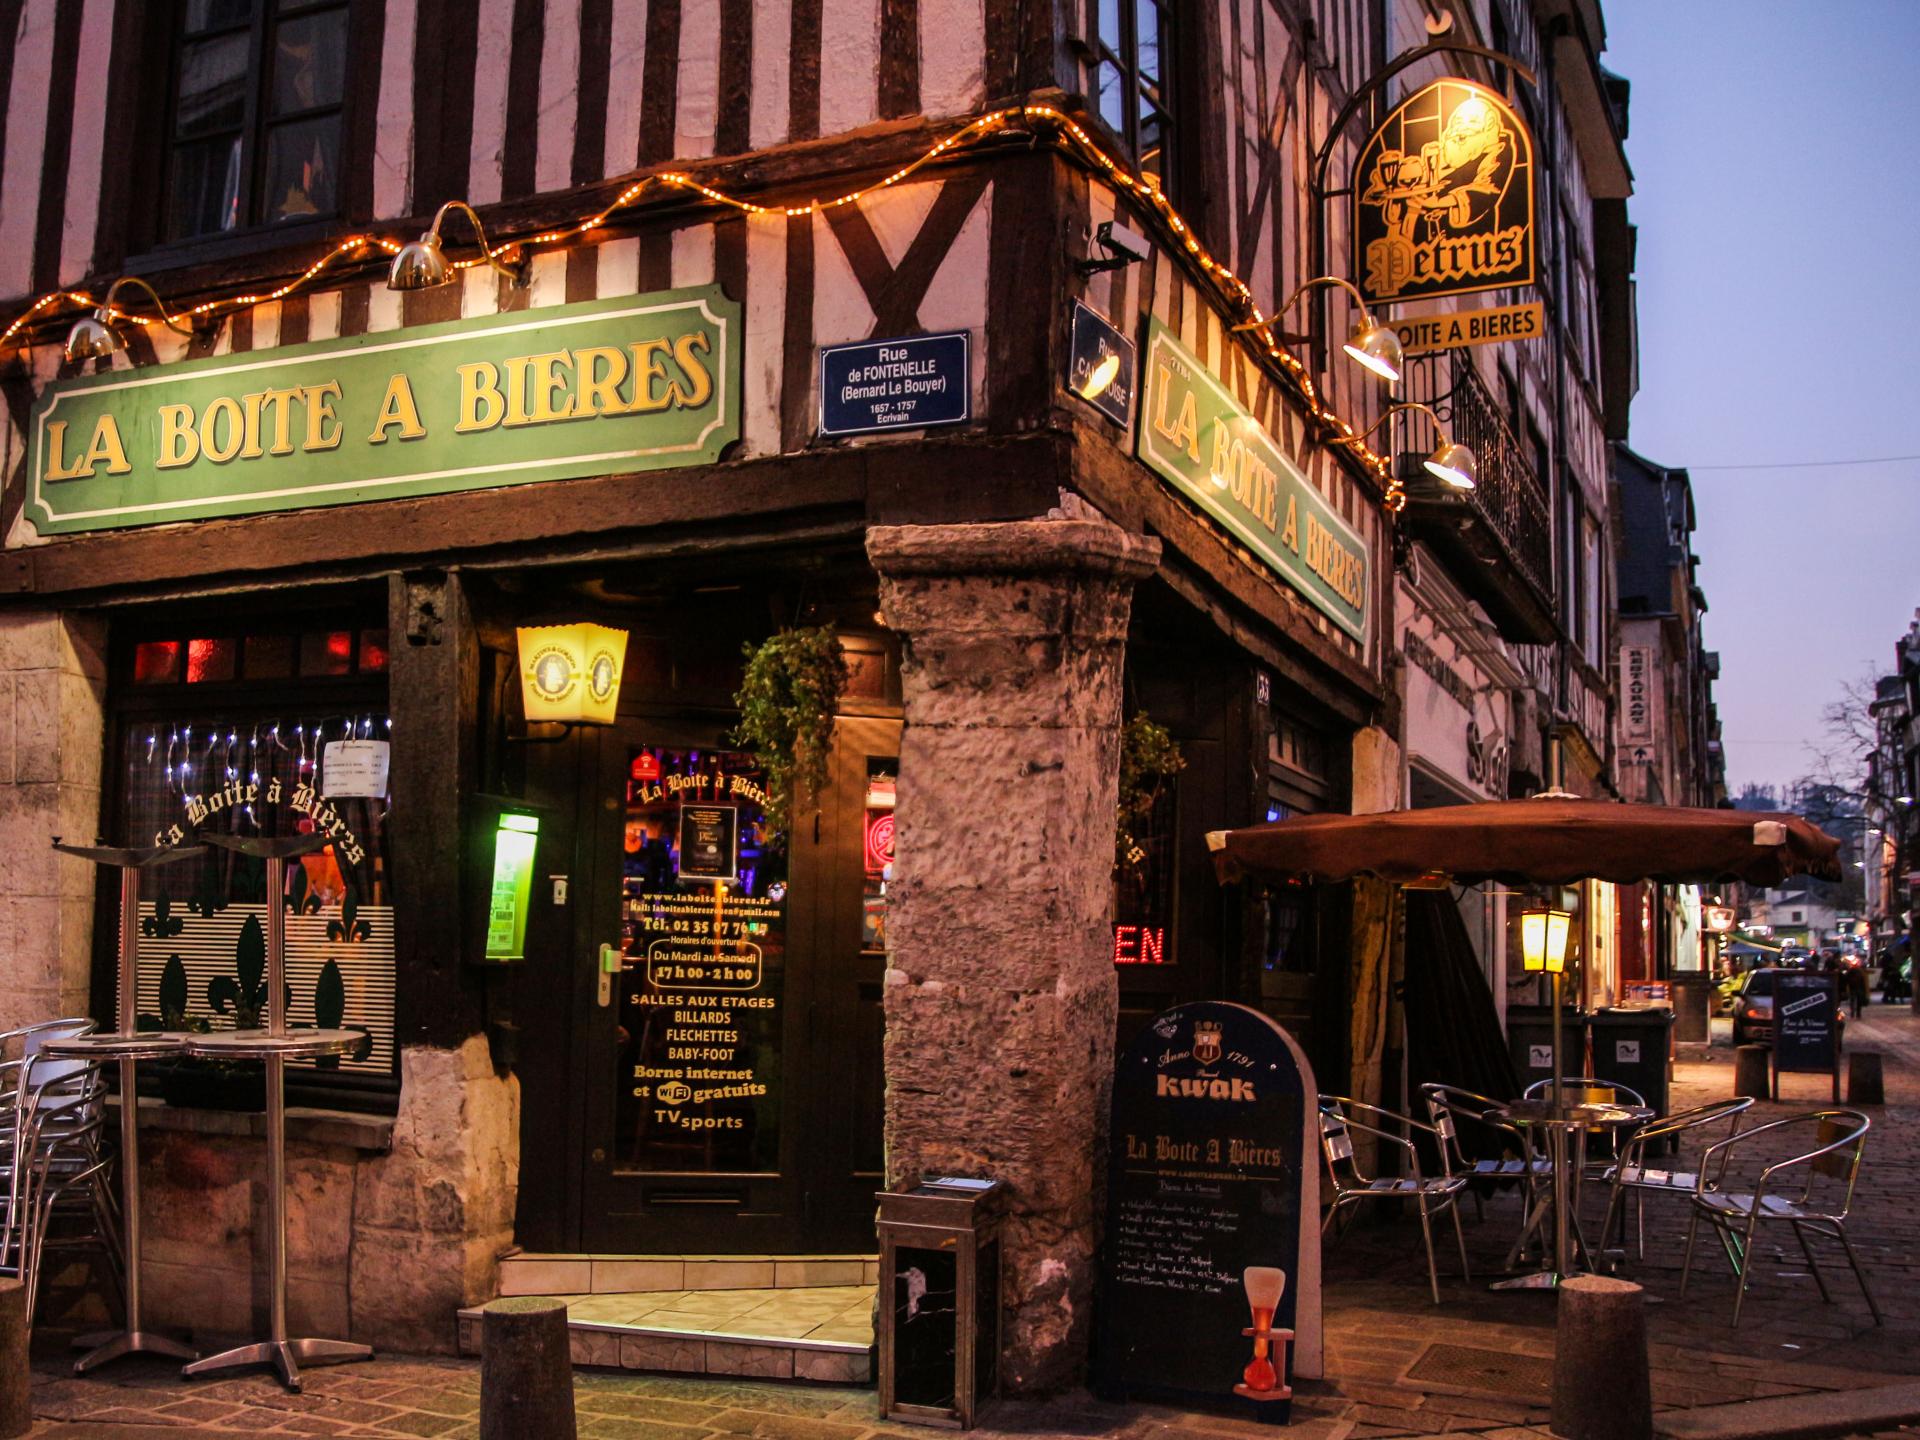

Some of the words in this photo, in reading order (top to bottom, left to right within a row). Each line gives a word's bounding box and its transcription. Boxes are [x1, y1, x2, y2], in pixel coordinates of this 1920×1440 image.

[1368, 227, 1522, 296] Petrus
[1398, 321, 1441, 347] OITE
[1448, 318, 1462, 341] A
[1469, 310, 1535, 339] BIERES
[879, 348, 908, 362] Rue
[848, 368, 861, 382] de
[864, 360, 936, 381] FONTENELLE
[841, 382, 886, 404] (Bernard
[889, 382, 902, 395] Le
[905, 375, 946, 395] Bouyer)
[1078, 357, 1127, 407] CAOISE
[45, 413, 132, 482] LA
[157, 380, 345, 469] BOITE
[369, 373, 427, 443] A
[455, 331, 712, 433] BIERES
[870, 403, 889, 414] 1657
[897, 400, 917, 411] 1757
[877, 413, 909, 424] Ecrivain
[1154, 364, 1201, 465] LA
[1209, 415, 1278, 532] BOITE
[1281, 494, 1300, 555] A
[1305, 510, 1364, 612] BIERES
[184, 779, 259, 827] Boite
[267, 776, 282, 803] à
[637, 785, 662, 804] La
[666, 771, 709, 794] Boite
[715, 771, 724, 789] à
[729, 774, 775, 812] Bièr
[643, 917, 669, 931] Tél.
[673, 920, 689, 932] 02
[693, 921, 708, 933] 35
[713, 922, 729, 935] 07
[733, 921, 748, 935] 76
[671, 936, 700, 945] Horaires
[701, 936, 741, 946] d'ouverture
[1114, 925, 1165, 964] EN
[654, 950, 669, 961] Du
[671, 951, 701, 962] Mardi
[703, 954, 715, 962] au
[718, 952, 756, 964] Samedi
[657, 966, 673, 978] 17
[675, 966, 684, 978] h
[687, 967, 703, 979] 00
[713, 969, 722, 979] 2
[724, 967, 733, 979] h
[736, 968, 753, 980] 00
[631, 994, 684, 1005] SALLES
[687, 995, 718, 1006] AUX
[721, 996, 775, 1008] ETAGES
[674, 1011, 731, 1024] BILLARDS
[666, 1029, 738, 1042] FLECHETTES
[668, 1048, 735, 1061] BABY-FOOT
[1157, 1047, 1190, 1068] Anno
[1226, 1050, 1257, 1068] 1791
[634, 1066, 684, 1078] Borne
[686, 1066, 753, 1080] internet
[633, 1085, 650, 1097] et
[658, 1085, 688, 1098] WiFi
[694, 1082, 766, 1103] gratuits
[1155, 1073, 1257, 1102] kwak
[654, 1109, 681, 1123] TV
[681, 1116, 743, 1131] sports
[1125, 1134, 1148, 1160] La
[1155, 1134, 1200, 1162] Boite
[1206, 1138, 1221, 1165] A
[1228, 1138, 1281, 1168] Bières
